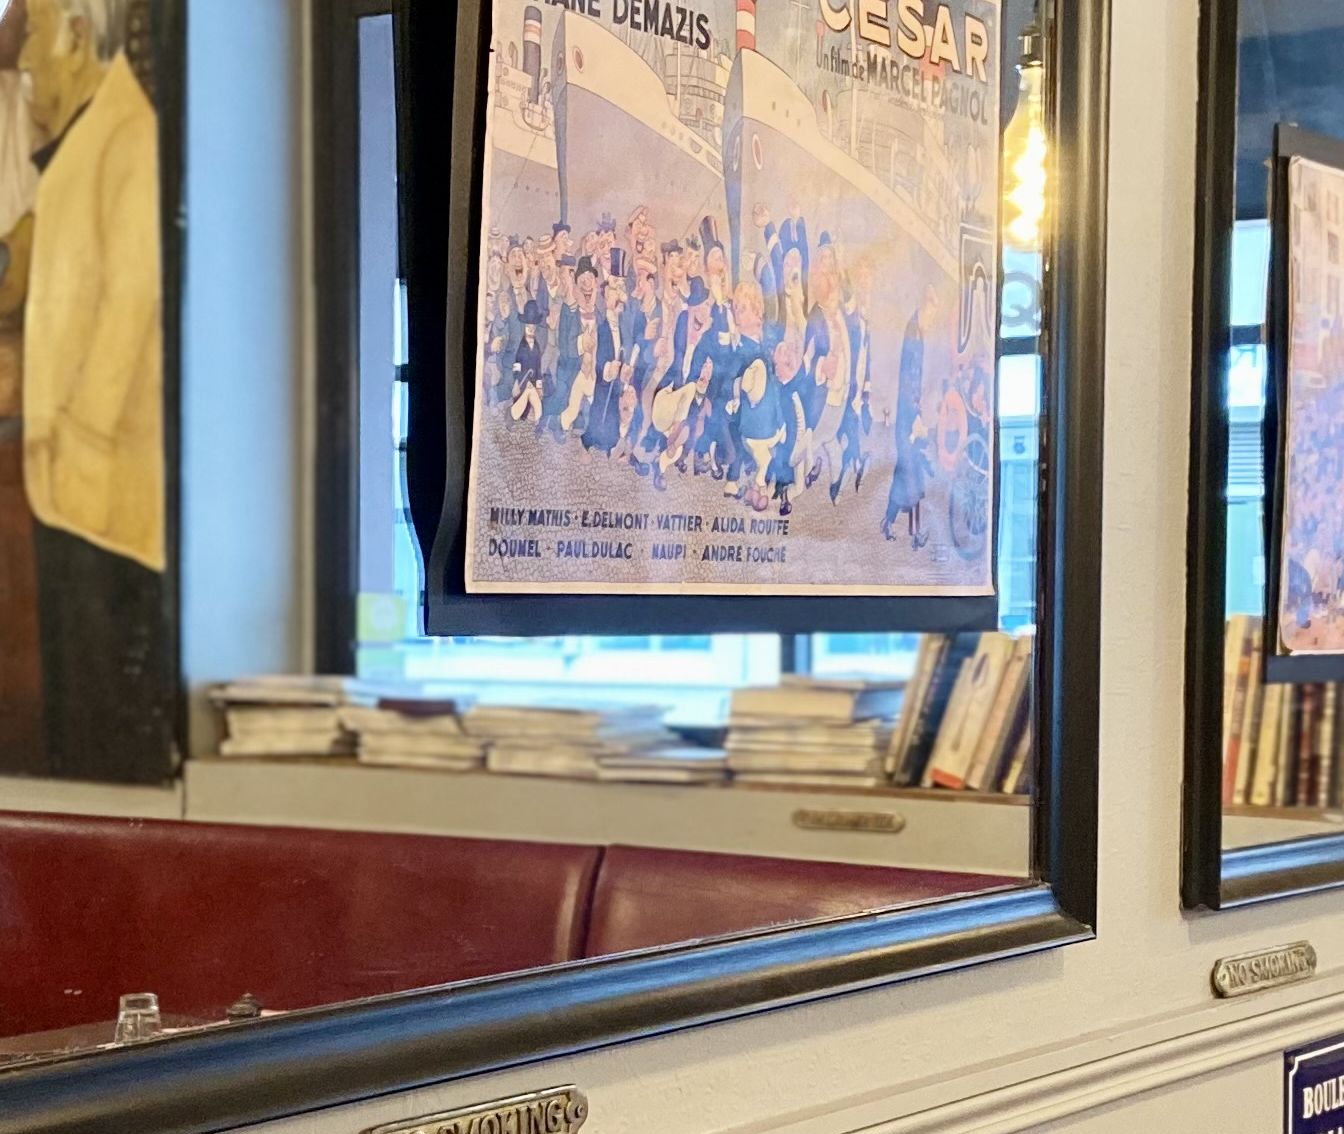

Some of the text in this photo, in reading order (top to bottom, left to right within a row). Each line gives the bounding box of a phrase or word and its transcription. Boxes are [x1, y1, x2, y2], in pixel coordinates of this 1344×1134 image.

[612, 0, 712, 50] DEMAZIS
[830, 45, 850, 76] film
[866, 50, 930, 102] MARCEL
[931, 74, 988, 125] PAGNOL
[489, 507, 525, 526] MILLY
[527, 509, 571, 527] MATHIS
[657, 514, 703, 533] VATTIER
[711, 516, 745, 534] ALIDA
[488, 538, 542, 557] DOUMEL
[651, 543, 687, 560] NAUPI
[1227, 962, 1247, 988] NO
